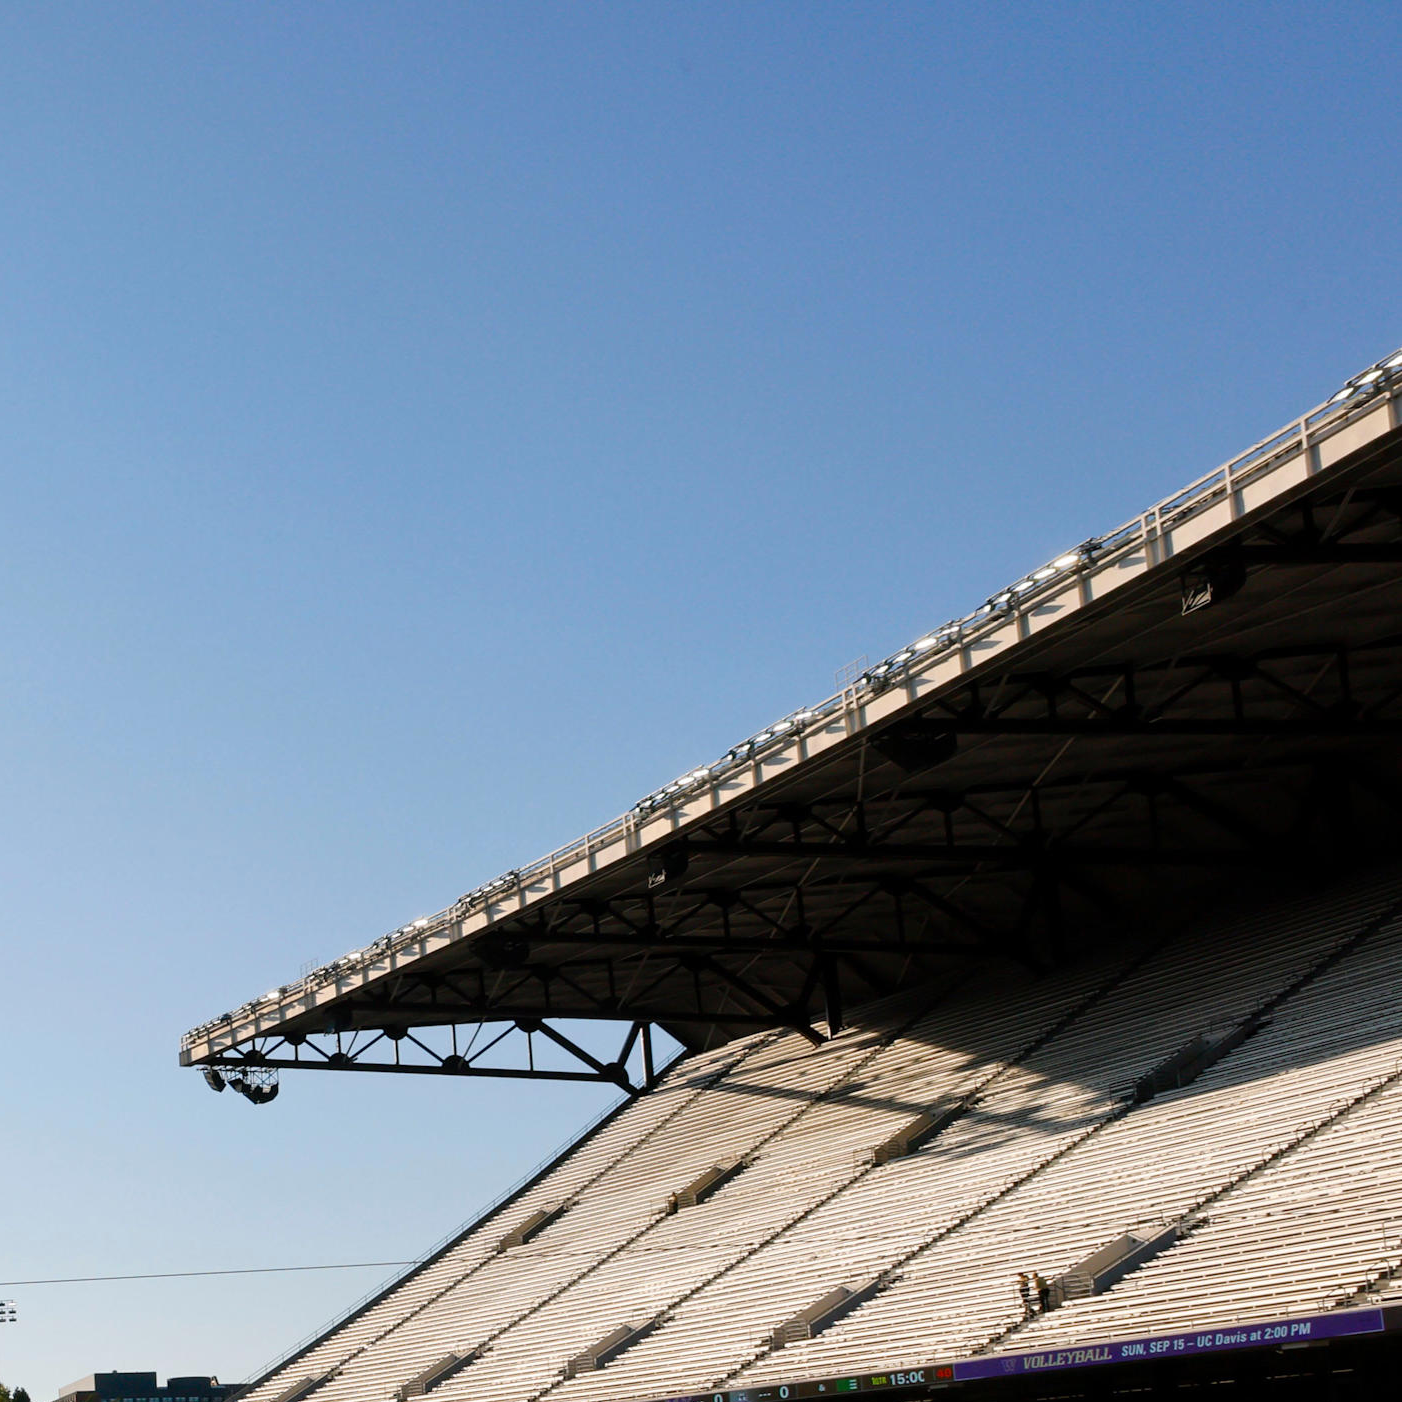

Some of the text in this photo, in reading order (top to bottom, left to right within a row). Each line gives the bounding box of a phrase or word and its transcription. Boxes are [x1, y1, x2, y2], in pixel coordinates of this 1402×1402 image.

[1022, 1348, 1113, 1370] VOLLEYBALL
[1121, 1343, 1146, 1357] SUN,
[1149, 1341, 1170, 1354] SEP
[1172, 1339, 1184, 1351] 15
[1197, 1334, 1212, 1348] UC
[1215, 1331, 1247, 1346] Davis
[1250, 1331, 1261, 1342] at
[1264, 1326, 1288, 1340] 2:00
[1290, 1322, 1311, 1337] PM
[779, 1385, 789, 1399] 0
